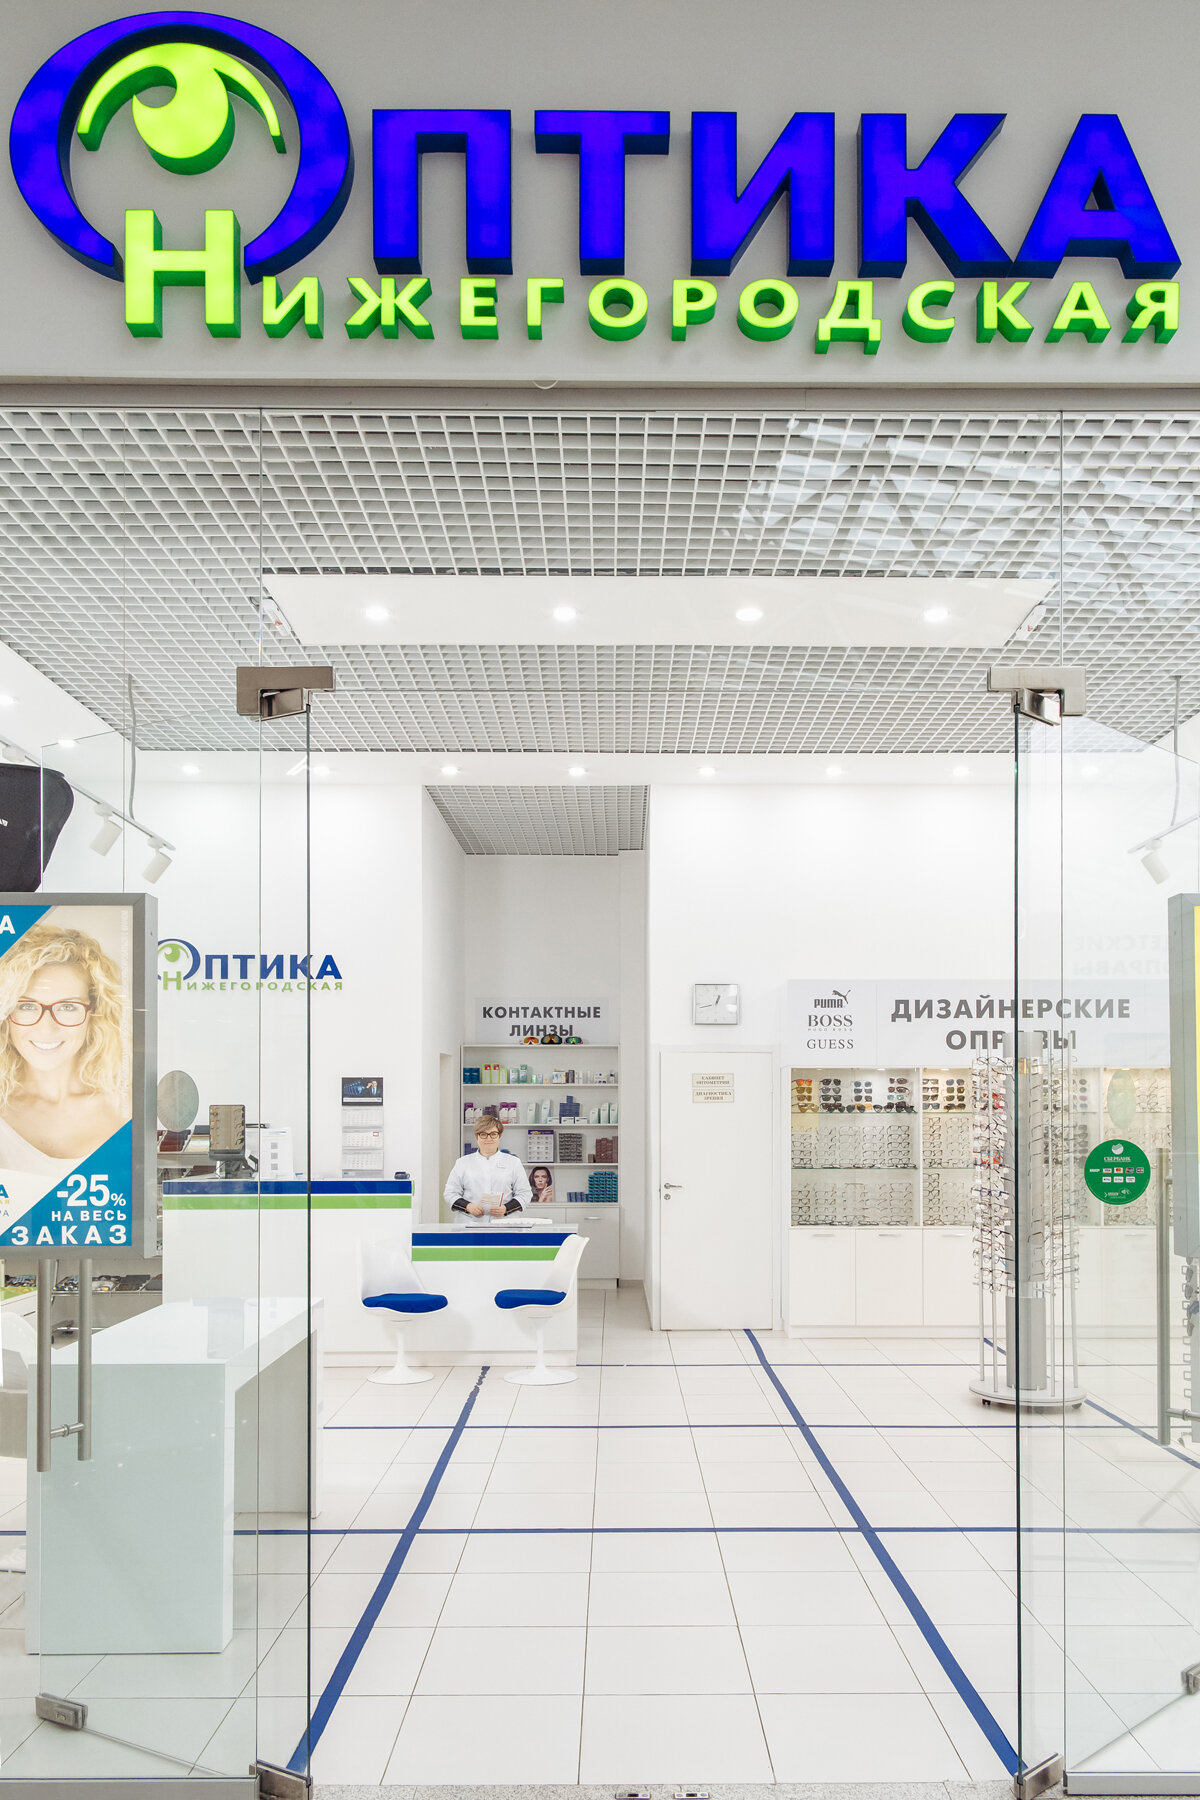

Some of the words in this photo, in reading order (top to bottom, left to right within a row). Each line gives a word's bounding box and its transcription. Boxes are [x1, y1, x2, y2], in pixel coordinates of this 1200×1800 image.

[9, 10, 1182, 284] ОПТИКА
[125, 209, 1181, 355] НИЖЕГОРОДСКАЯ
[158, 938, 342, 980] ОПТИКА
[163, 971, 343, 992] НИЖЕГОРОДСКАЯ
[482, 1006, 601, 1019] КОНТАКТНЫЕ
[813, 998, 843, 1009] PUMA
[891, 994, 1131, 1022] ДИЗАЙНЕРСКИЕ
[509, 1024, 573, 1036] ЛИНЗЫ
[808, 1014, 853, 1027] BOSS
[806, 1039, 854, 1049] GUESS
[945, 1030, 1077, 1050] ОПРВЫ
[57, 1174, 127, 1207] -25%
[51, 1210, 74, 1222] НА
[80, 1210, 127, 1222] ВЕСЬ
[11, 1225, 127, 1246] ЗАКАЗ
